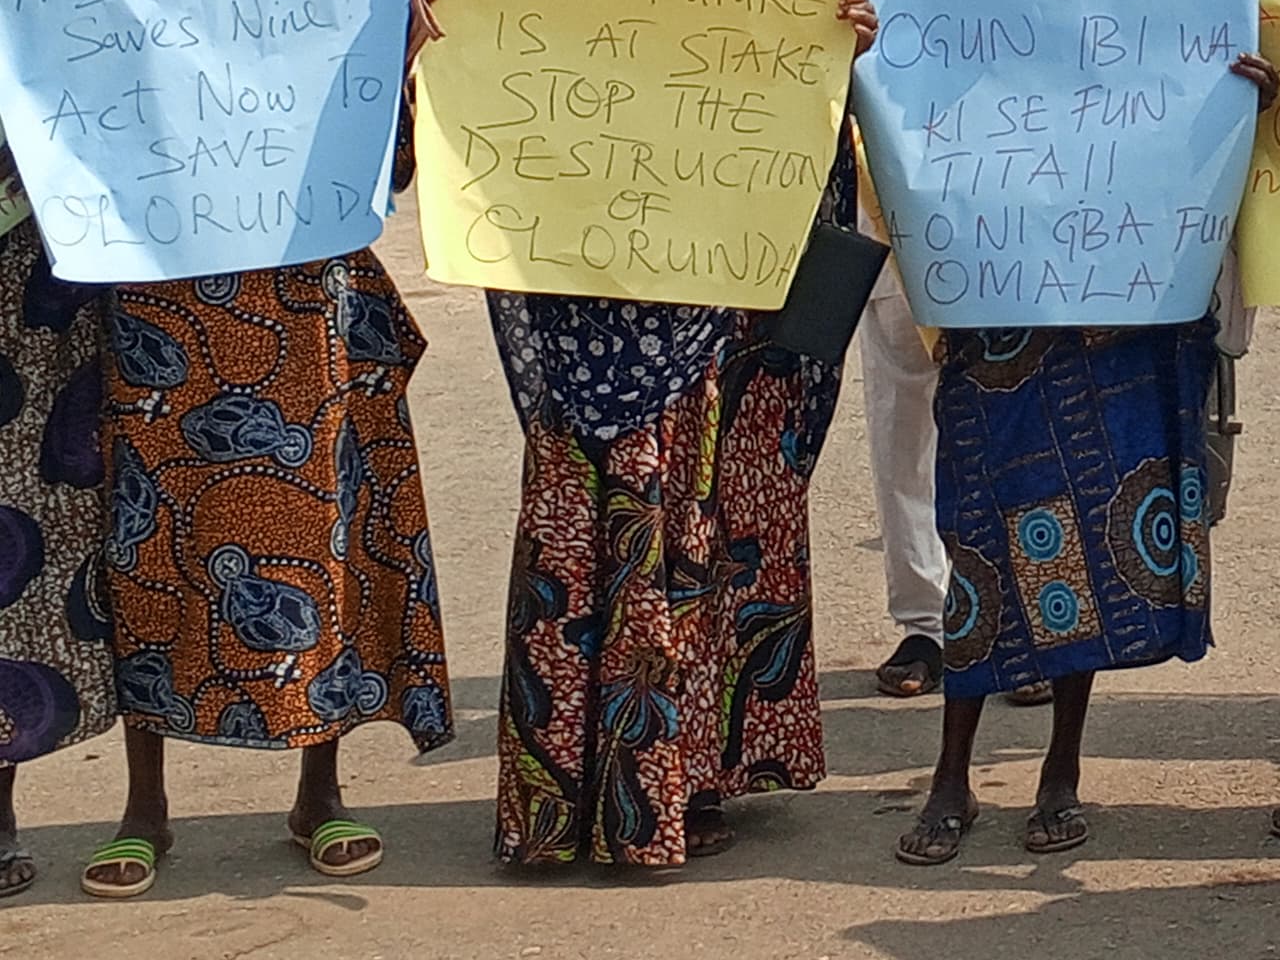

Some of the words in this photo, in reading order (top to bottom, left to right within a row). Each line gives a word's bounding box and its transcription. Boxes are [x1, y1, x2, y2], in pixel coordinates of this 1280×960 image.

[64, 15, 200, 62] Saves
[496, 11, 547, 56] IS
[585, 18, 658, 59] AT
[880, 13, 1036, 69] OGUN
[1179, 21, 1238, 63] WA
[42, 80, 161, 141] Act
[198, 62, 297, 121] Now
[328, 53, 383, 109] To
[476, 67, 636, 130] STOP
[664, 82, 778, 134] THE
[923, 101, 964, 148] KI
[987, 94, 1049, 139] SE
[1071, 78, 1167, 134] FUN
[137, 127, 296, 181] SAVE
[460, 124, 824, 193] DESTRUCTION
[41, 181, 374, 248] OLORUND
[607, 190, 672, 226] OF
[1052, 202, 1154, 263] GBA
[466, 204, 797, 289] OLORUNDA
